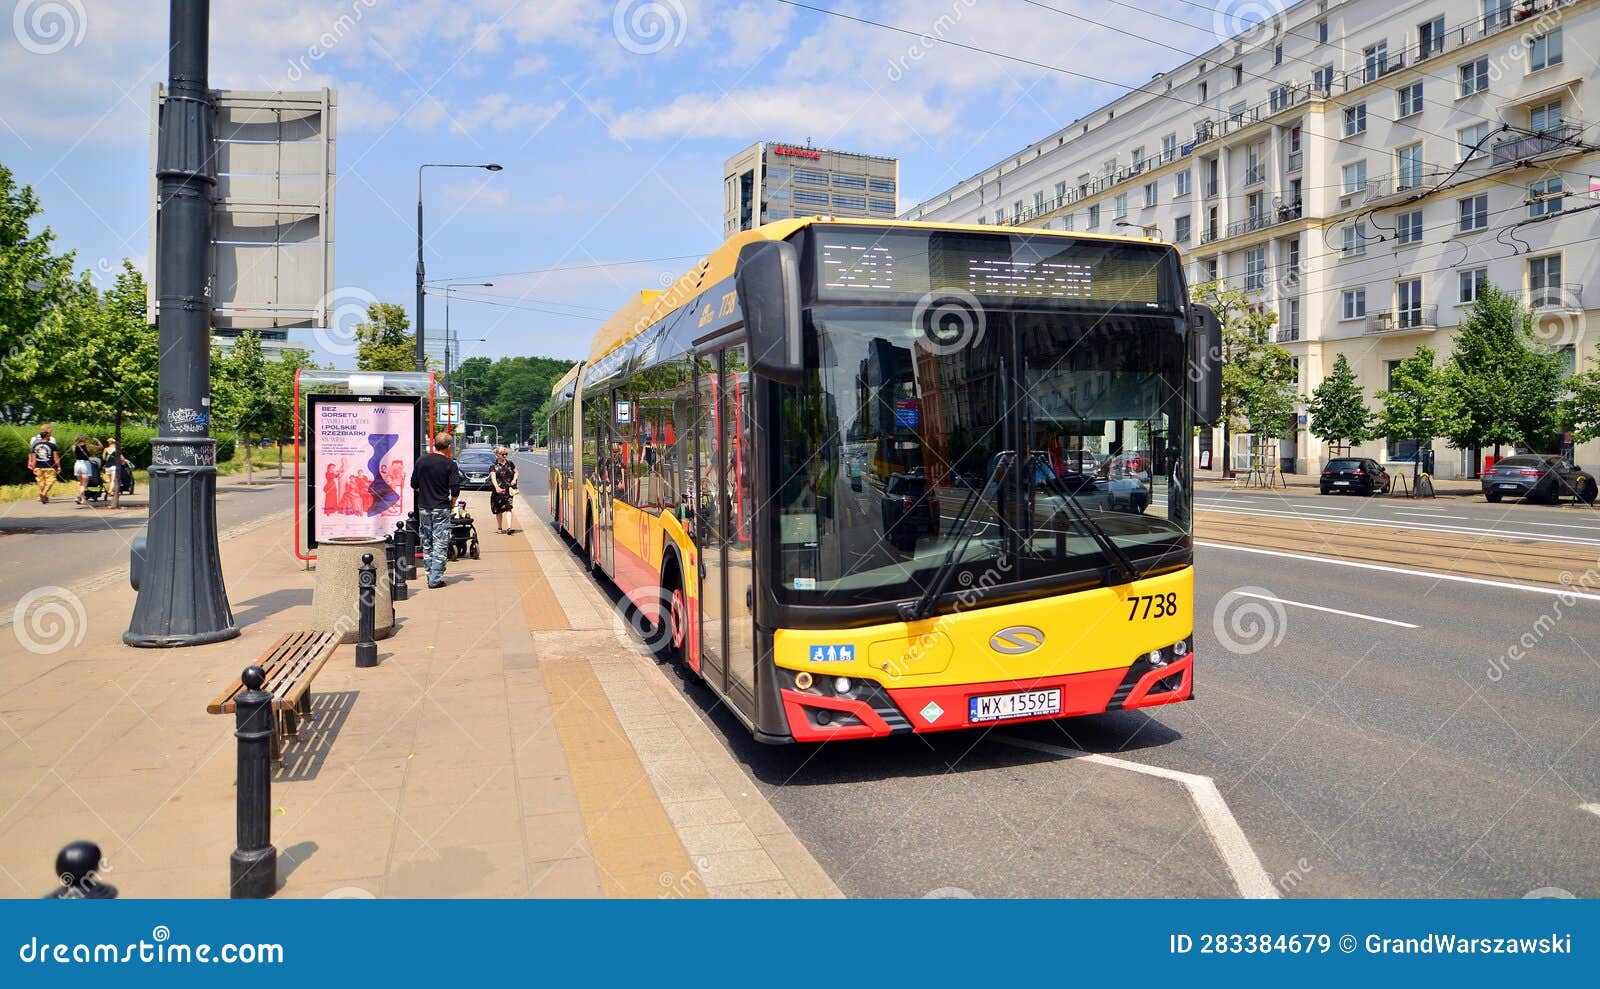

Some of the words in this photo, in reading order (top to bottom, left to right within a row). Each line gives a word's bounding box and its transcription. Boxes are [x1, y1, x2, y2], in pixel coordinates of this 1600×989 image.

[1127, 592, 1178, 621] 7738
[981, 697, 1002, 714] WX
[1009, 691, 1056, 712] 1559E
